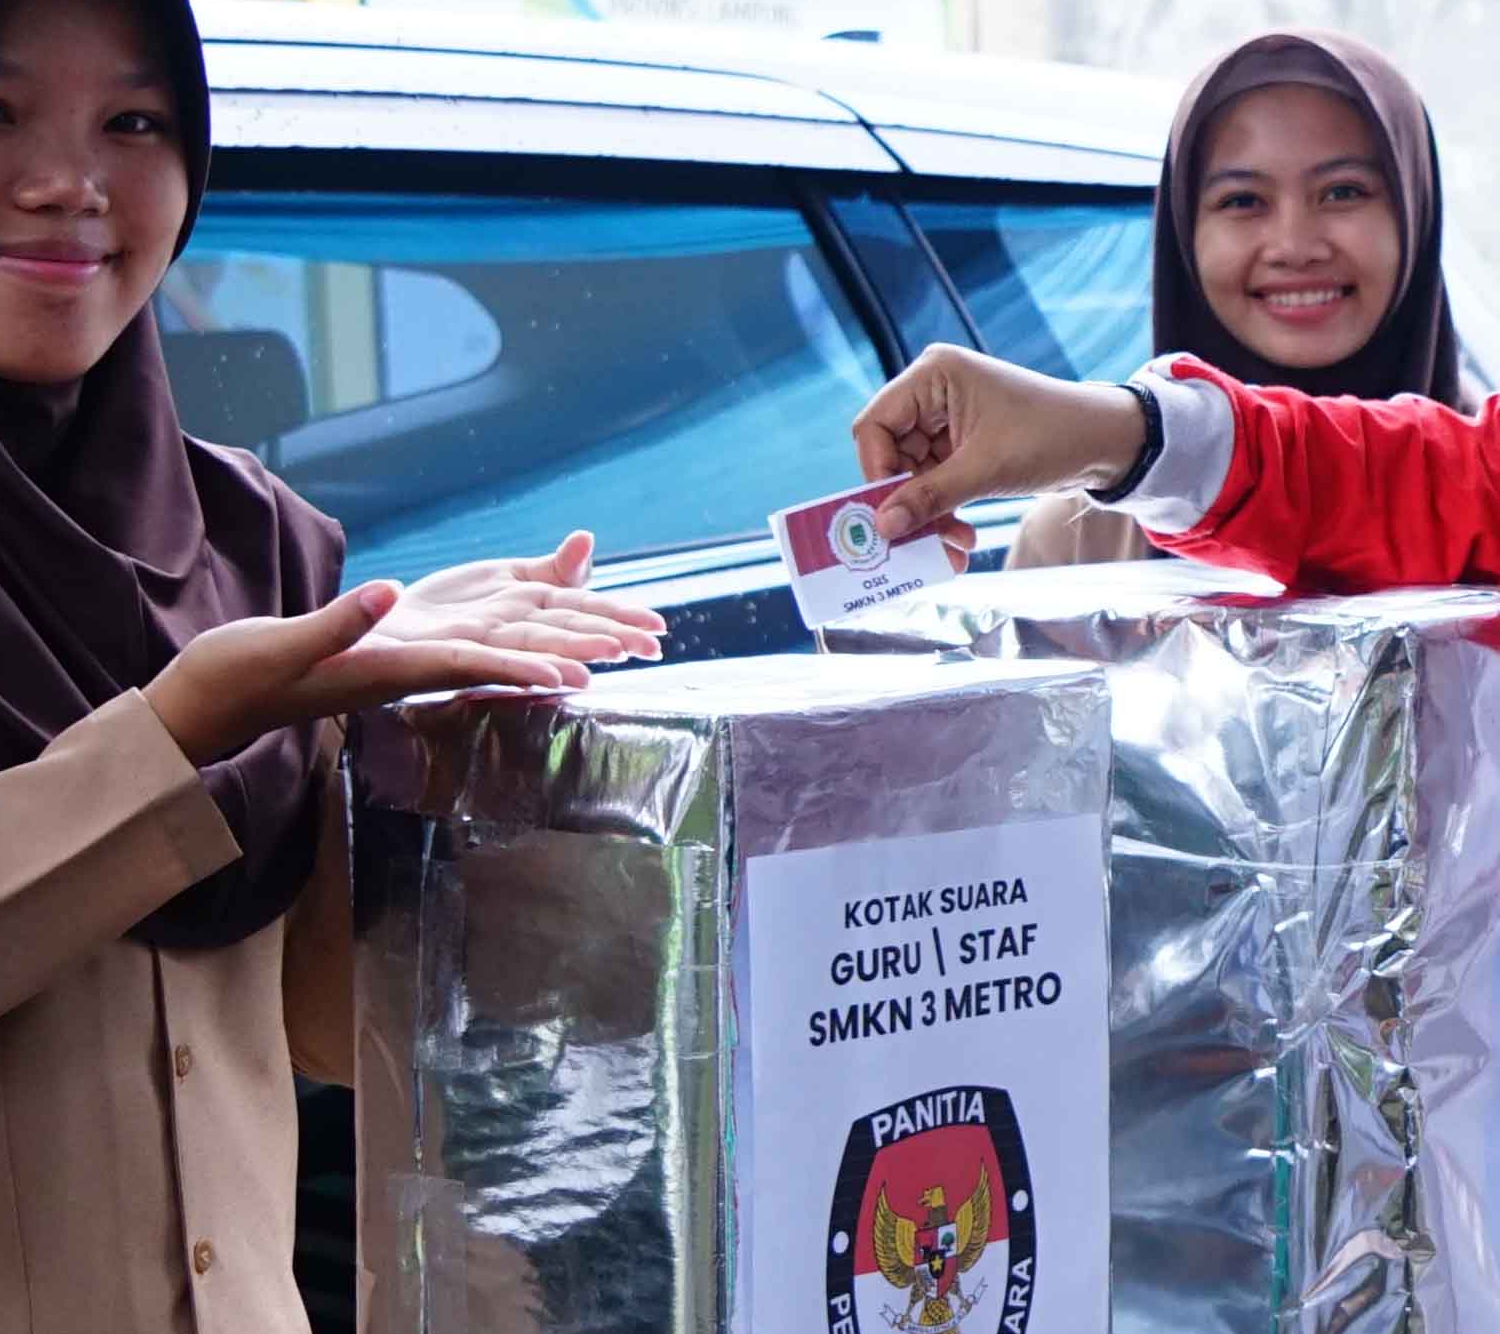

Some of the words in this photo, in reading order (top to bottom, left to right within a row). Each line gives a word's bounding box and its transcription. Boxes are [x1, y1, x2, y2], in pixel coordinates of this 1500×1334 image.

[886, 578, 924, 599] METRO
[844, 889, 933, 929] KOTAK
[940, 877, 1028, 914] SUARA
[830, 941, 921, 986] GURU
[959, 922, 1038, 965] STAF
[809, 996, 913, 1047] SMKN
[920, 990, 937, 1027] 3
[944, 971, 1062, 1023] METRO
[871, 1090, 986, 1149] PANITIA
